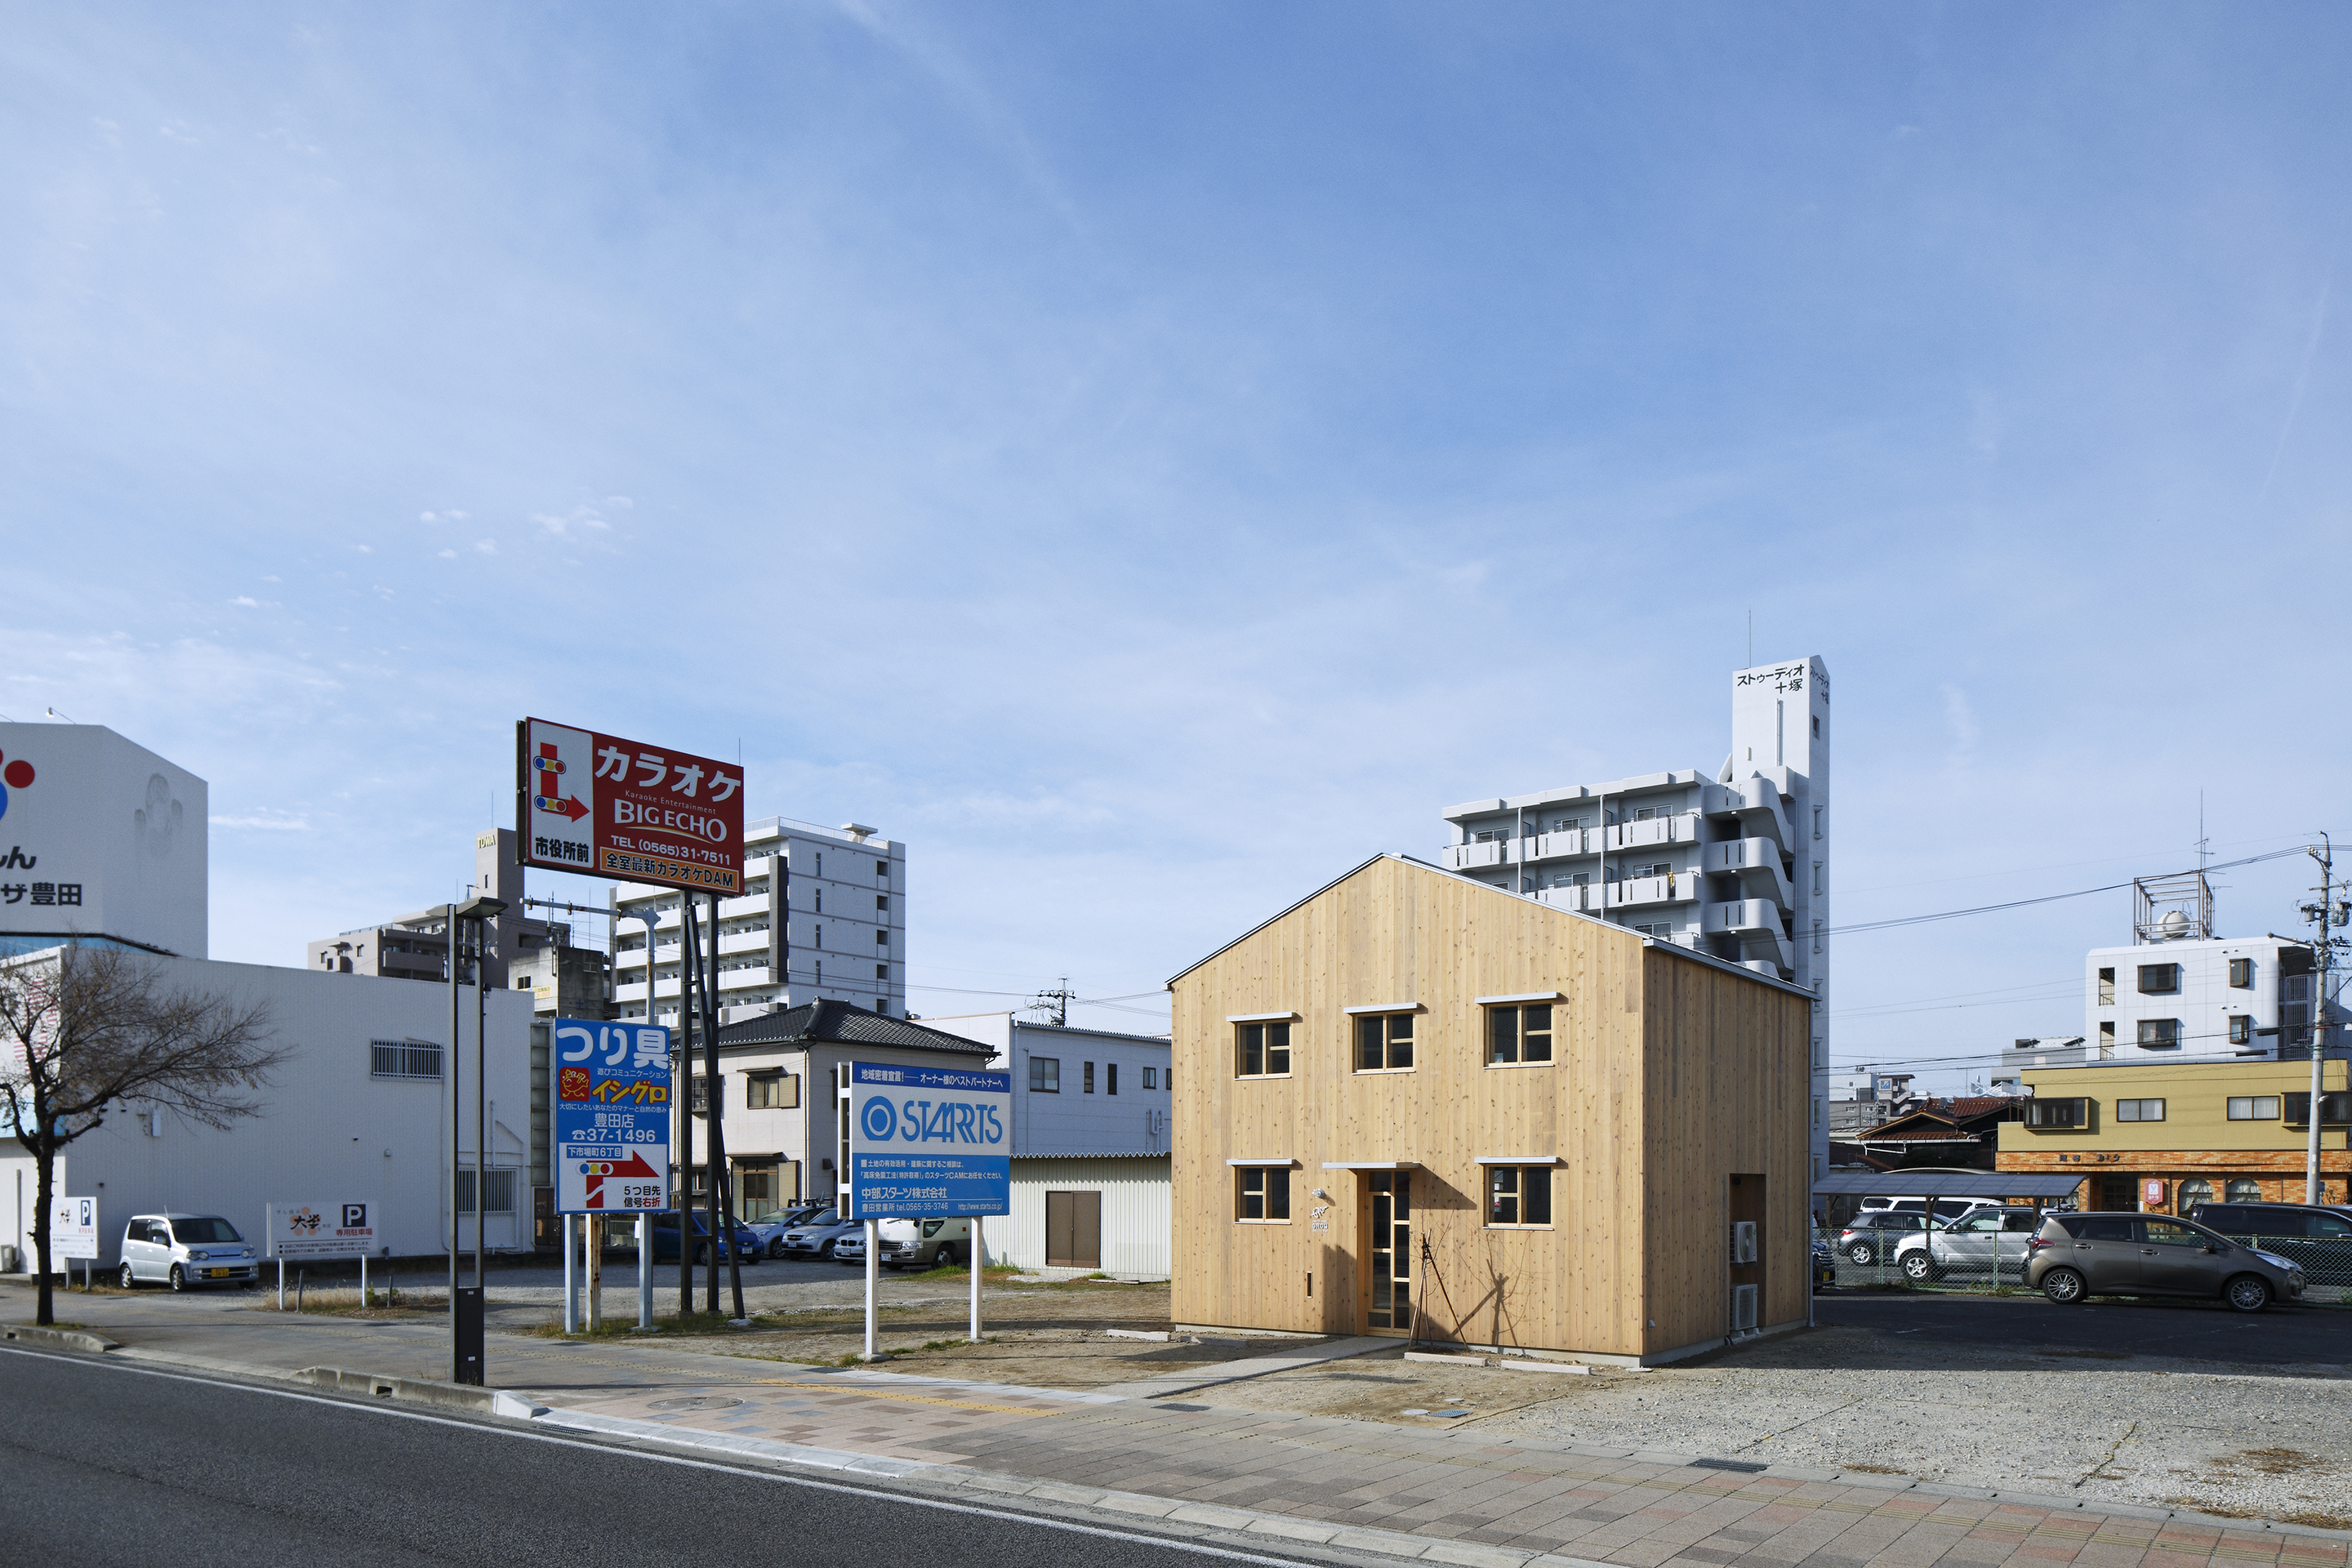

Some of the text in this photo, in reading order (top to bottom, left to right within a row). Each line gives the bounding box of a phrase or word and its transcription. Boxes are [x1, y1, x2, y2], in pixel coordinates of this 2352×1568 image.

[1737, 664, 1804, 687] ストゥーディオ
[1775, 678, 1803, 694] 十塚
[595, 746, 741, 802] カラオケ
[625, 789, 716, 815] Karaoke Entertainment
[614, 798, 728, 843] BIG ECHO
[477, 835, 496, 849] TOWA
[535, 836, 590, 863] 市役所前
[611, 834, 636, 849] TEL
[606, 852, 733, 888] 全室最新カラオケDAM
[0, 882, 82, 906] ザ豊田
[556, 1027, 669, 1070] つり具
[597, 1067, 667, 1079] 遊びコミュニケーション
[920, 1073, 1004, 1088] オーナー様のベストパートナーへ
[591, 1078, 667, 1105] イシグロ
[559, 1102, 667, 1114] 大切にしたいあなたのマナーと自然の恵み
[594, 1113, 635, 1129] 豊田店
[901, 1099, 1003, 1143] STARTS
[586, 1129, 657, 1143] 37-1496
[568, 1147, 621, 1157] 下市場町6丁目
[624, 1186, 661, 1196] 5つ目先
[861, 1187, 947, 1200] 中部スターツ株式会社
[623, 1197, 661, 1208] 信号右折
[862, 1203, 895, 1213] 豊田営業所
[82, 1201, 90, 1224] P
[346, 1205, 363, 1227] P
[336, 1228, 372, 1236] 専用駐車場
